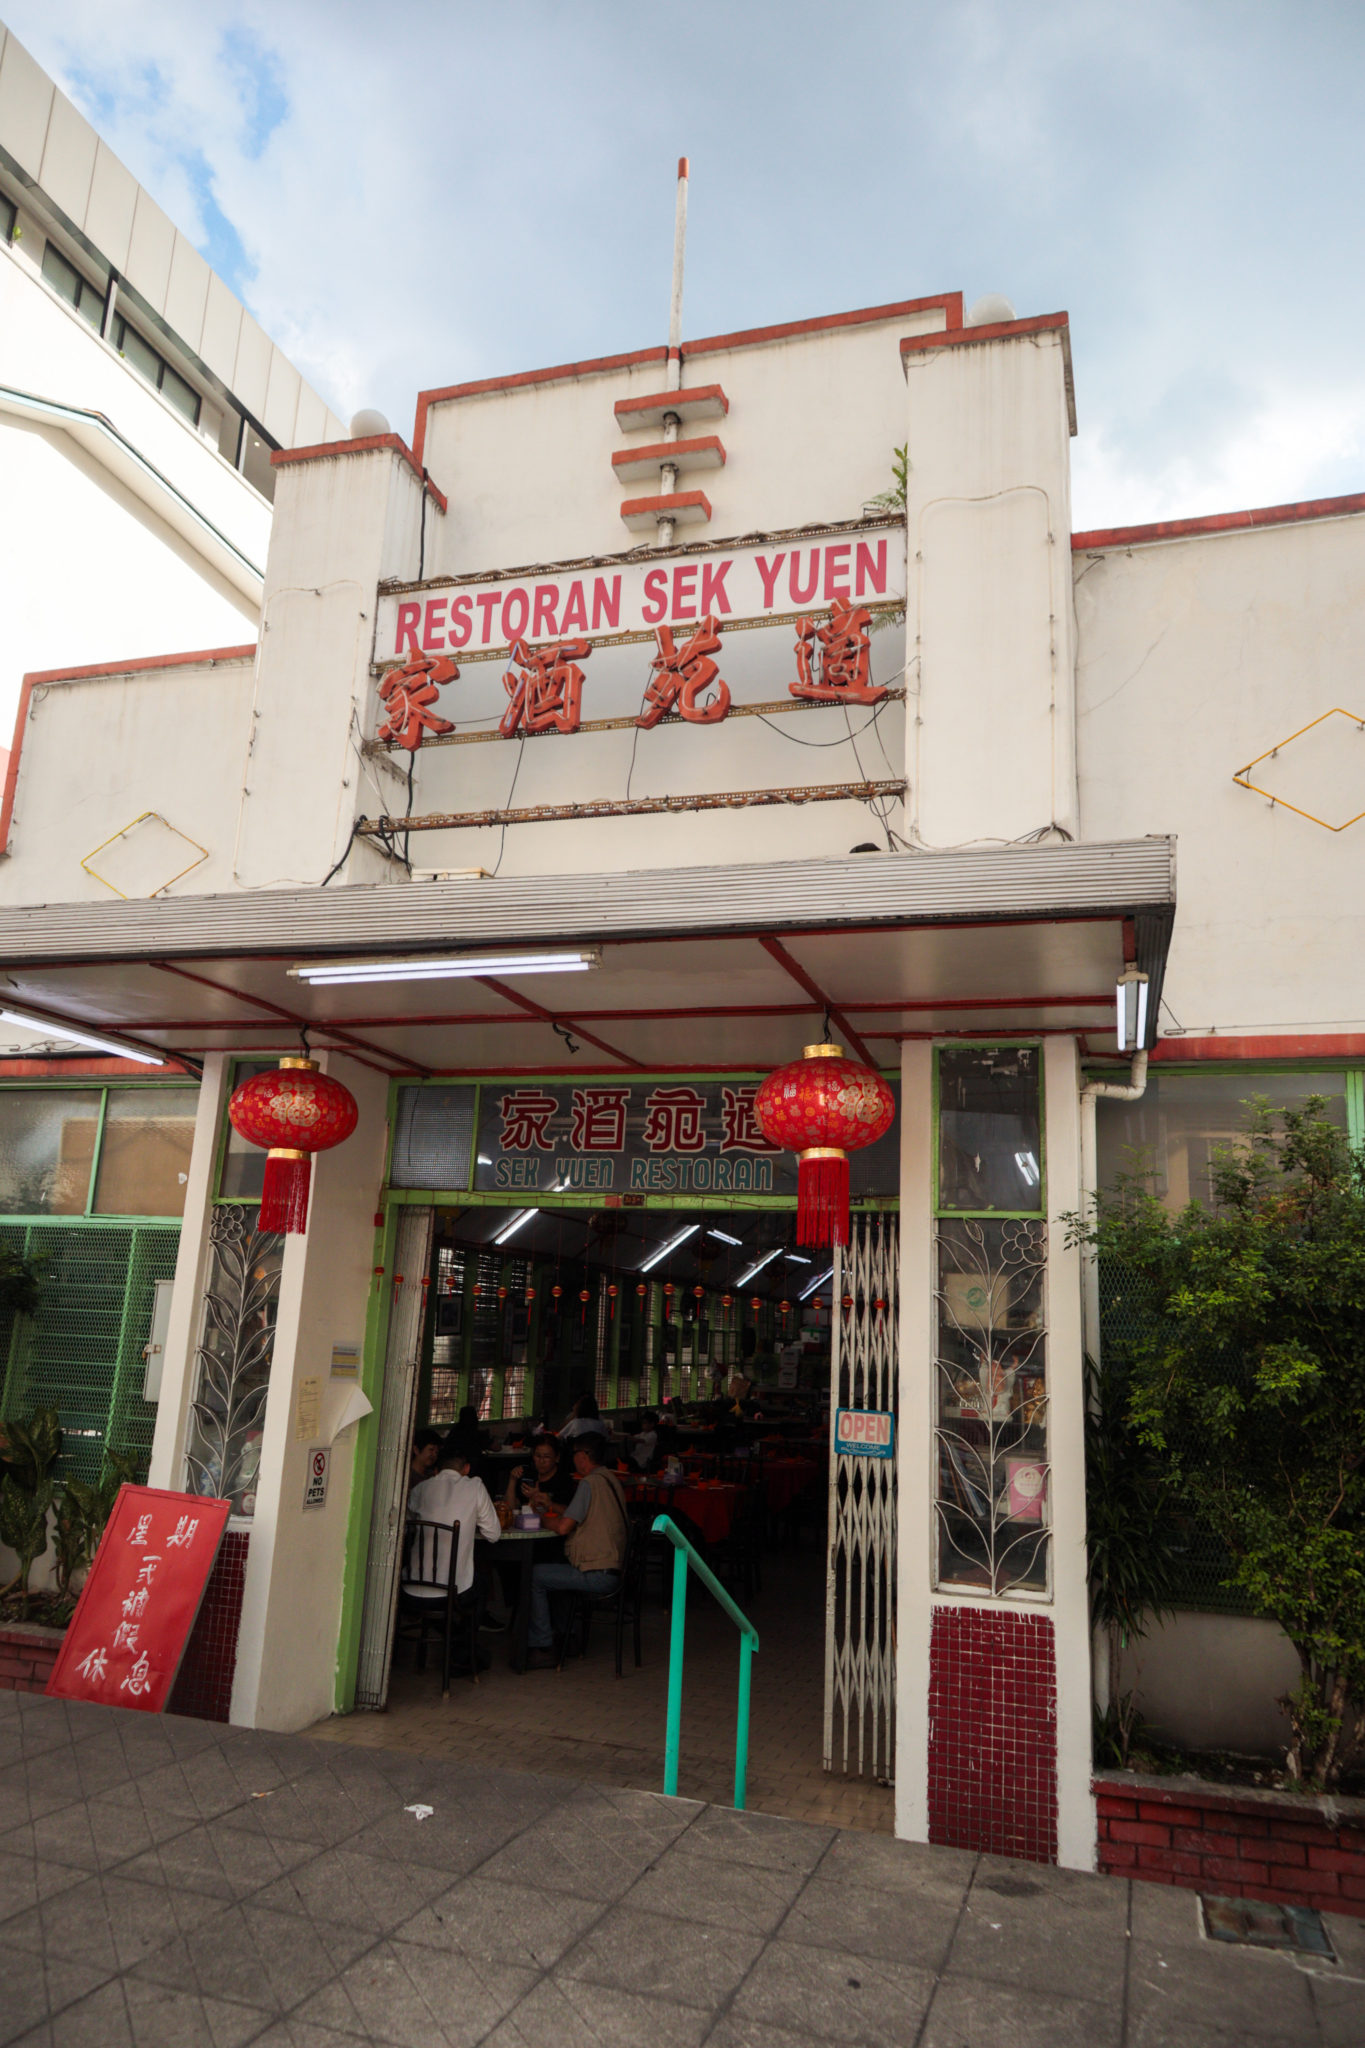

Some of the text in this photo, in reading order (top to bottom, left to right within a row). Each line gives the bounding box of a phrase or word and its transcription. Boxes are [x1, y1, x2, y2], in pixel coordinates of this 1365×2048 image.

[394, 539, 888, 655] RESTORAN SEK YUEN
[496, 1157, 540, 1187] SEK
[840, 1413, 889, 1443] OPEN
[846, 1441, 880, 1449] WELCOME
[313, 1477, 323, 1486] NO
[308, 1487, 324, 1497] PETS
